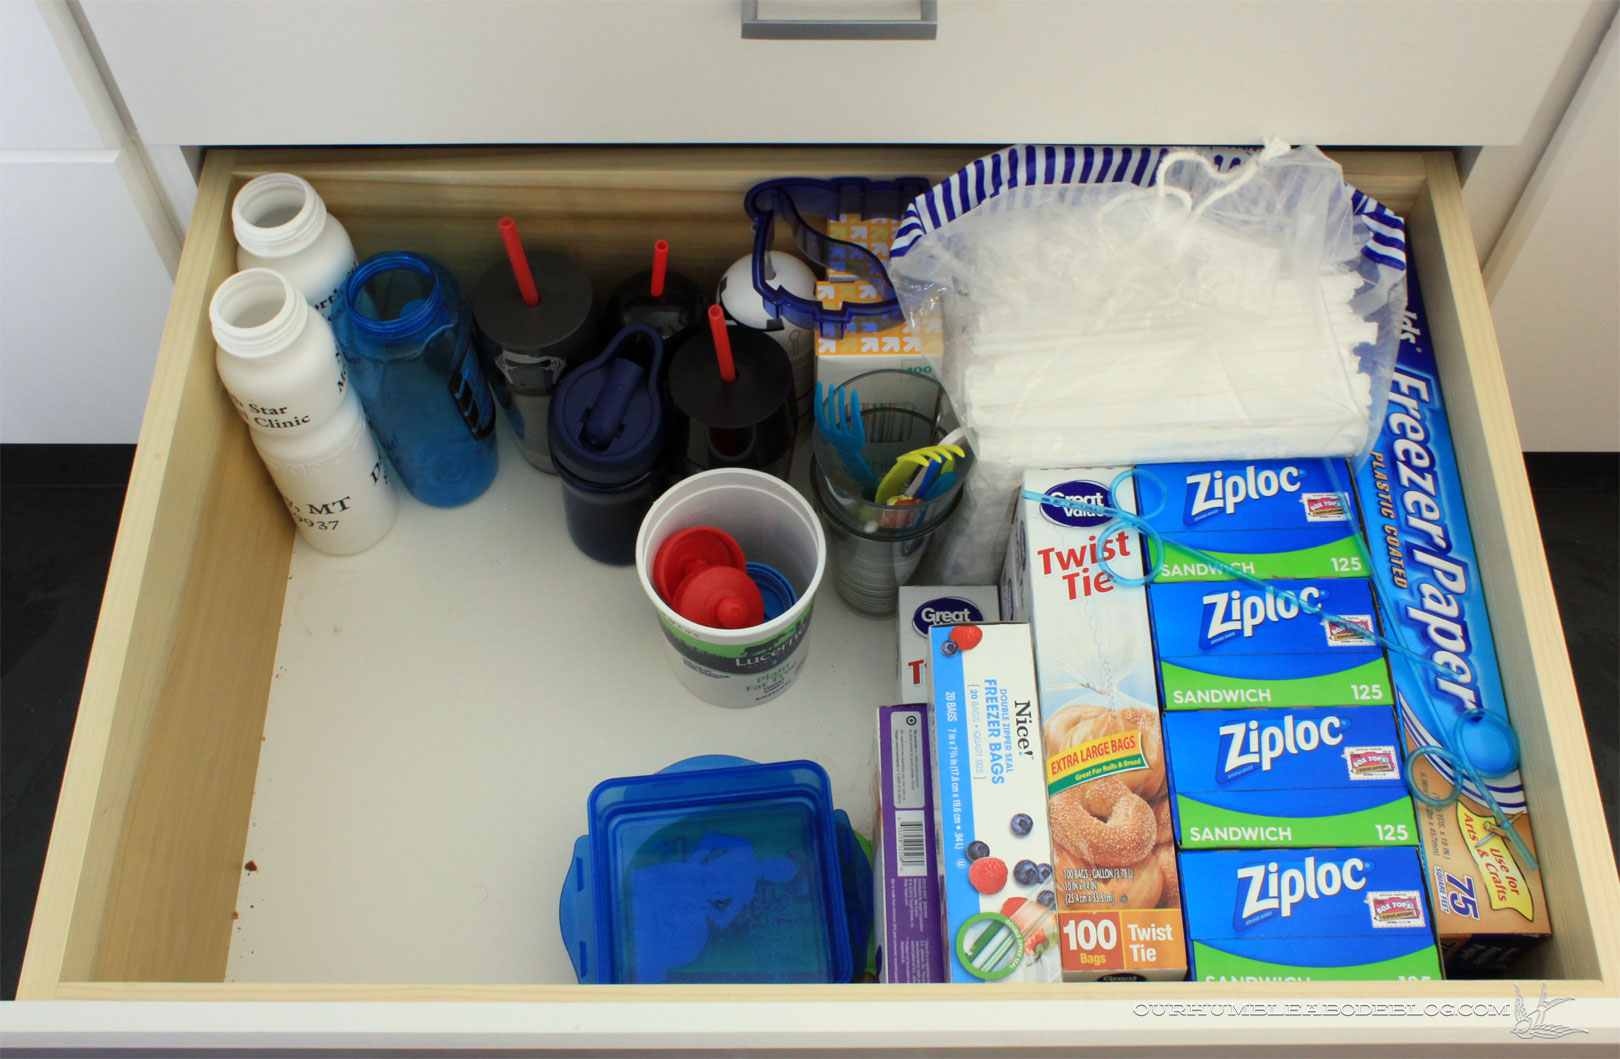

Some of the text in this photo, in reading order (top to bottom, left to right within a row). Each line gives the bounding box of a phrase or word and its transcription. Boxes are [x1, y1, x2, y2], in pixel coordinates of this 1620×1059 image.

[249, 403, 288, 415] Star
[254, 414, 311, 429] Clinic
[1186, 466, 1301, 516] Ziploc
[307, 496, 351, 515] MT
[1370, 450, 1408, 588] PLASTIC COATED
[1037, 531, 1131, 576] Twist
[1388, 371, 1477, 711] Freezer Paper
[1161, 562, 1255, 577] SANDWCH
[1331, 557, 1362, 573] 125
[1062, 568, 1114, 601] Tie
[921, 607, 971, 623] Great
[1202, 586, 1322, 639] Ziploc
[970, 689, 978, 699] 20
[1173, 688, 1272, 704] SANDWICH
[1350, 684, 1383, 700] 125
[947, 701, 957, 722] BAGS
[984, 679, 1005, 784] FREEZER BAGS
[1000, 689, 1014, 773] DOUBLE ZIPPER SEAL
[1014, 700, 1034, 756] Nice!
[1051, 735, 1136, 775] EXTRA LARGE BAGS
[1219, 715, 1343, 772] Ziploc
[1075, 769, 1092, 781] Great
[1092, 765, 1103, 775] For
[1103, 763, 1118, 773] Rolls
[1123, 758, 1141, 767] Bread
[1190, 827, 1292, 841] SANDWICH
[1375, 824, 1409, 841] 125
[1463, 813, 1507, 902] Arts & Crafts
[1074, 868, 1089, 879] BAGS
[1092, 868, 1114, 879] GALLON
[1489, 848, 1519, 896] Use for
[1237, 856, 1367, 919] Ziploc
[1435, 868, 1450, 912] SQUARE FEET
[1445, 872, 1480, 920] 75
[1063, 919, 1118, 951] 100
[1127, 923, 1173, 941] Twist
[1080, 952, 1106, 966] Bags
[1129, 943, 1157, 962] Tie
